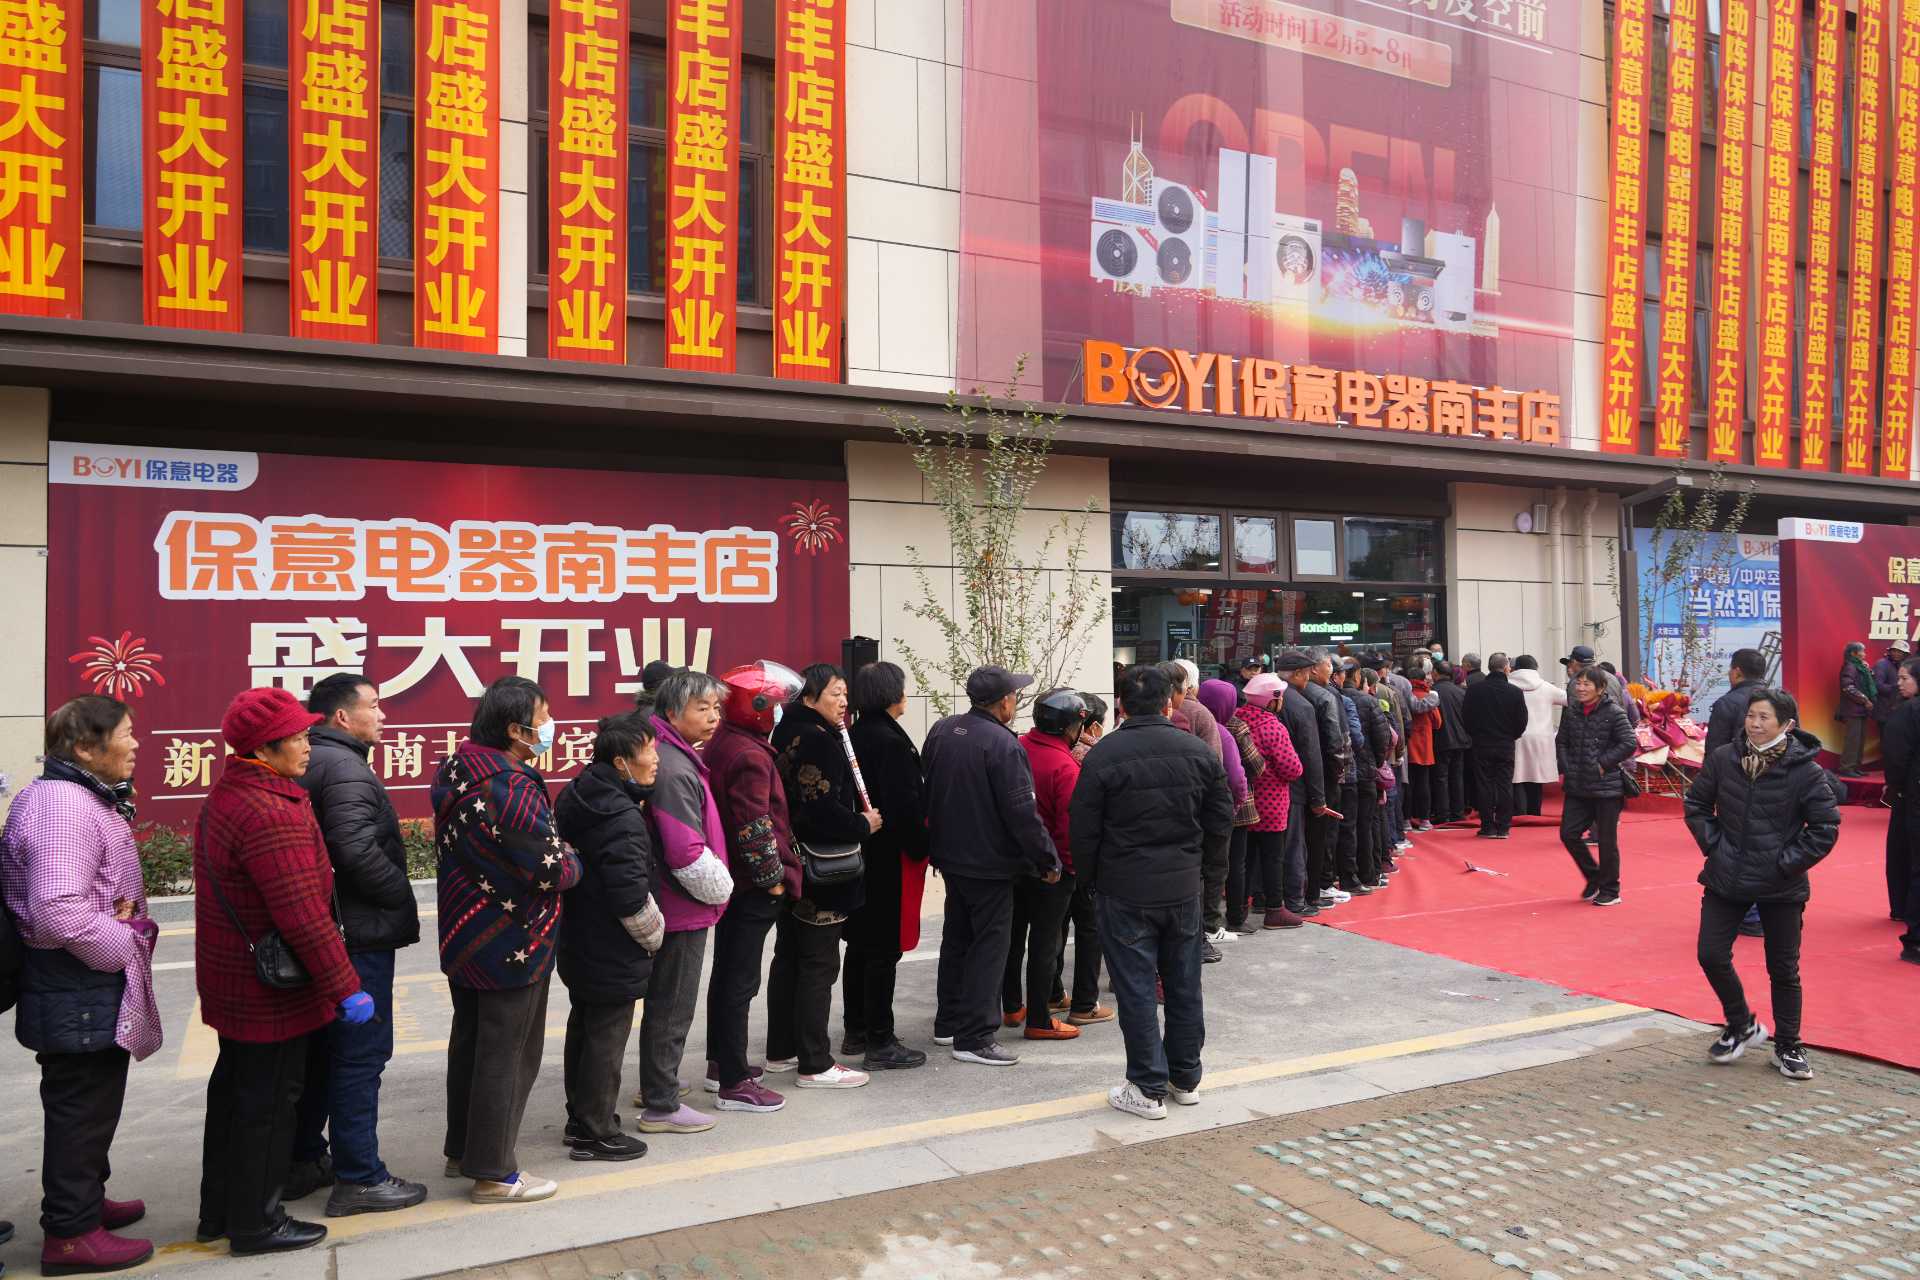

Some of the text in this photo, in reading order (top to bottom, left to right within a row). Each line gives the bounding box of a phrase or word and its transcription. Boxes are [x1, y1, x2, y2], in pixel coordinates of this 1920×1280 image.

[0, 0, 68, 299] 盛大开业
[301, 0, 368, 326] 店盛大开业
[424, 3, 488, 338] 店盛大开业
[669, 0, 731, 359] 丰店盛大开业
[780, 0, 835, 369] 丰店盛大开业
[1159, 93, 1457, 205] OPEN
[1083, 339, 1562, 445] BOYI 保意电器南丰店
[73, 455, 239, 484] BOYI 保意电器
[160, 513, 775, 601] 保意电器南丰店
[248, 616, 713, 703] 盛大开业
[1300, 622, 1343, 633] Ronshen
[1868, 592, 1920, 643] 盛
